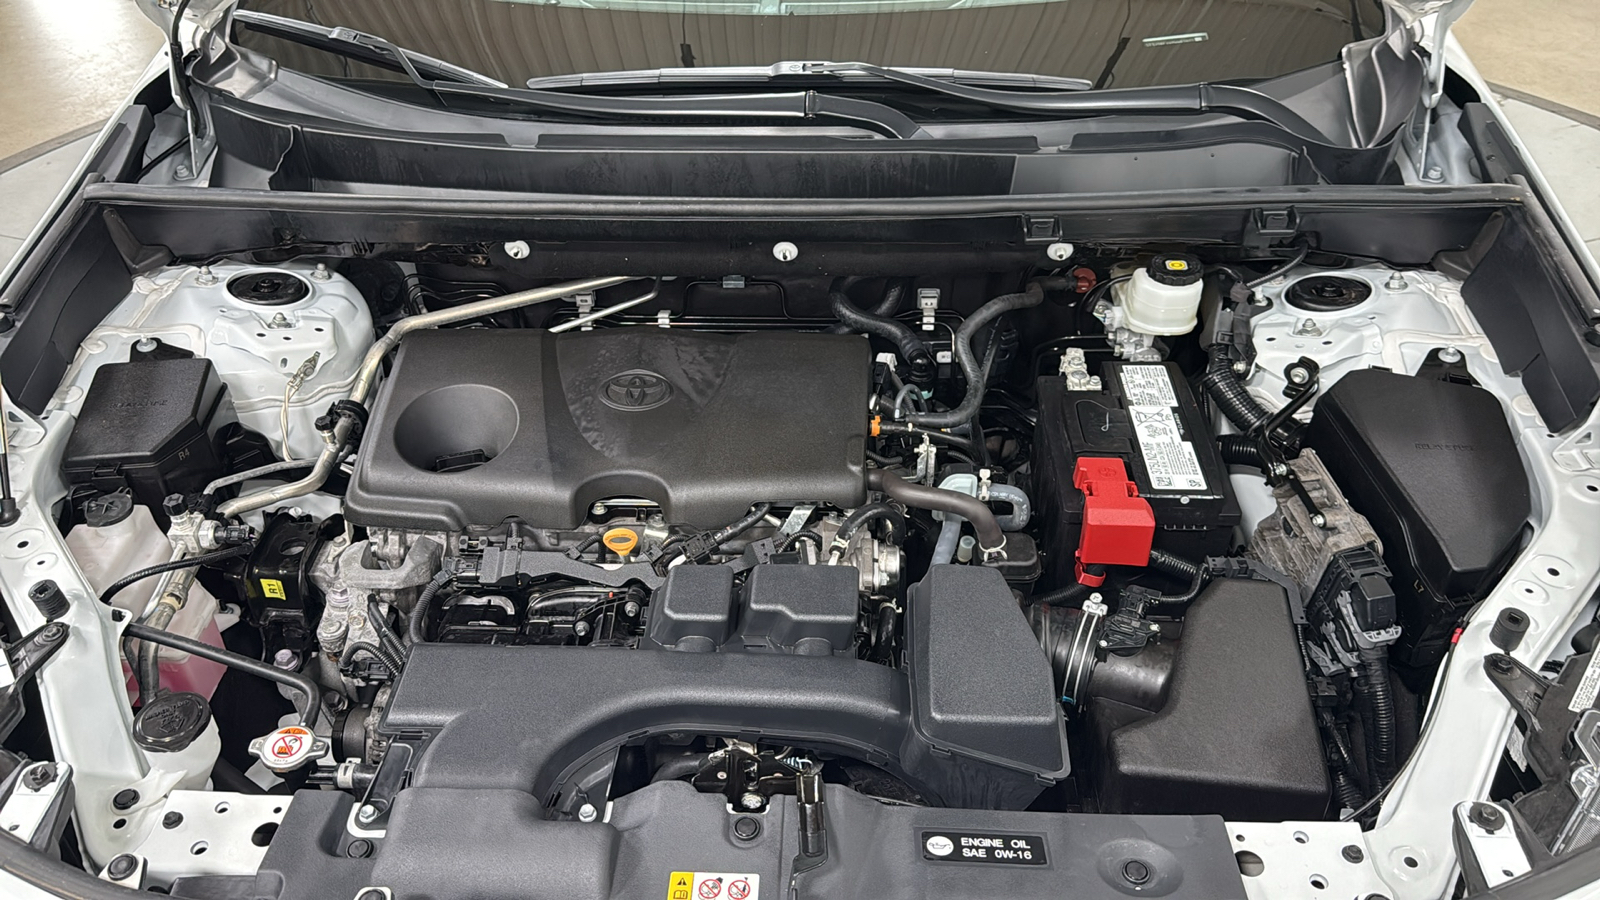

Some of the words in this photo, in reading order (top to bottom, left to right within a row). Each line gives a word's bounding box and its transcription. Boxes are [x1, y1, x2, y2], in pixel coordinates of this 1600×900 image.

[178, 448, 190, 461] R4
[267, 583, 278, 594] R1
[960, 837, 1004, 848] ENGINE
[1011, 839, 1031, 849] OIL
[962, 847, 987, 858] SAE
[994, 849, 1033, 860] 0W-16
